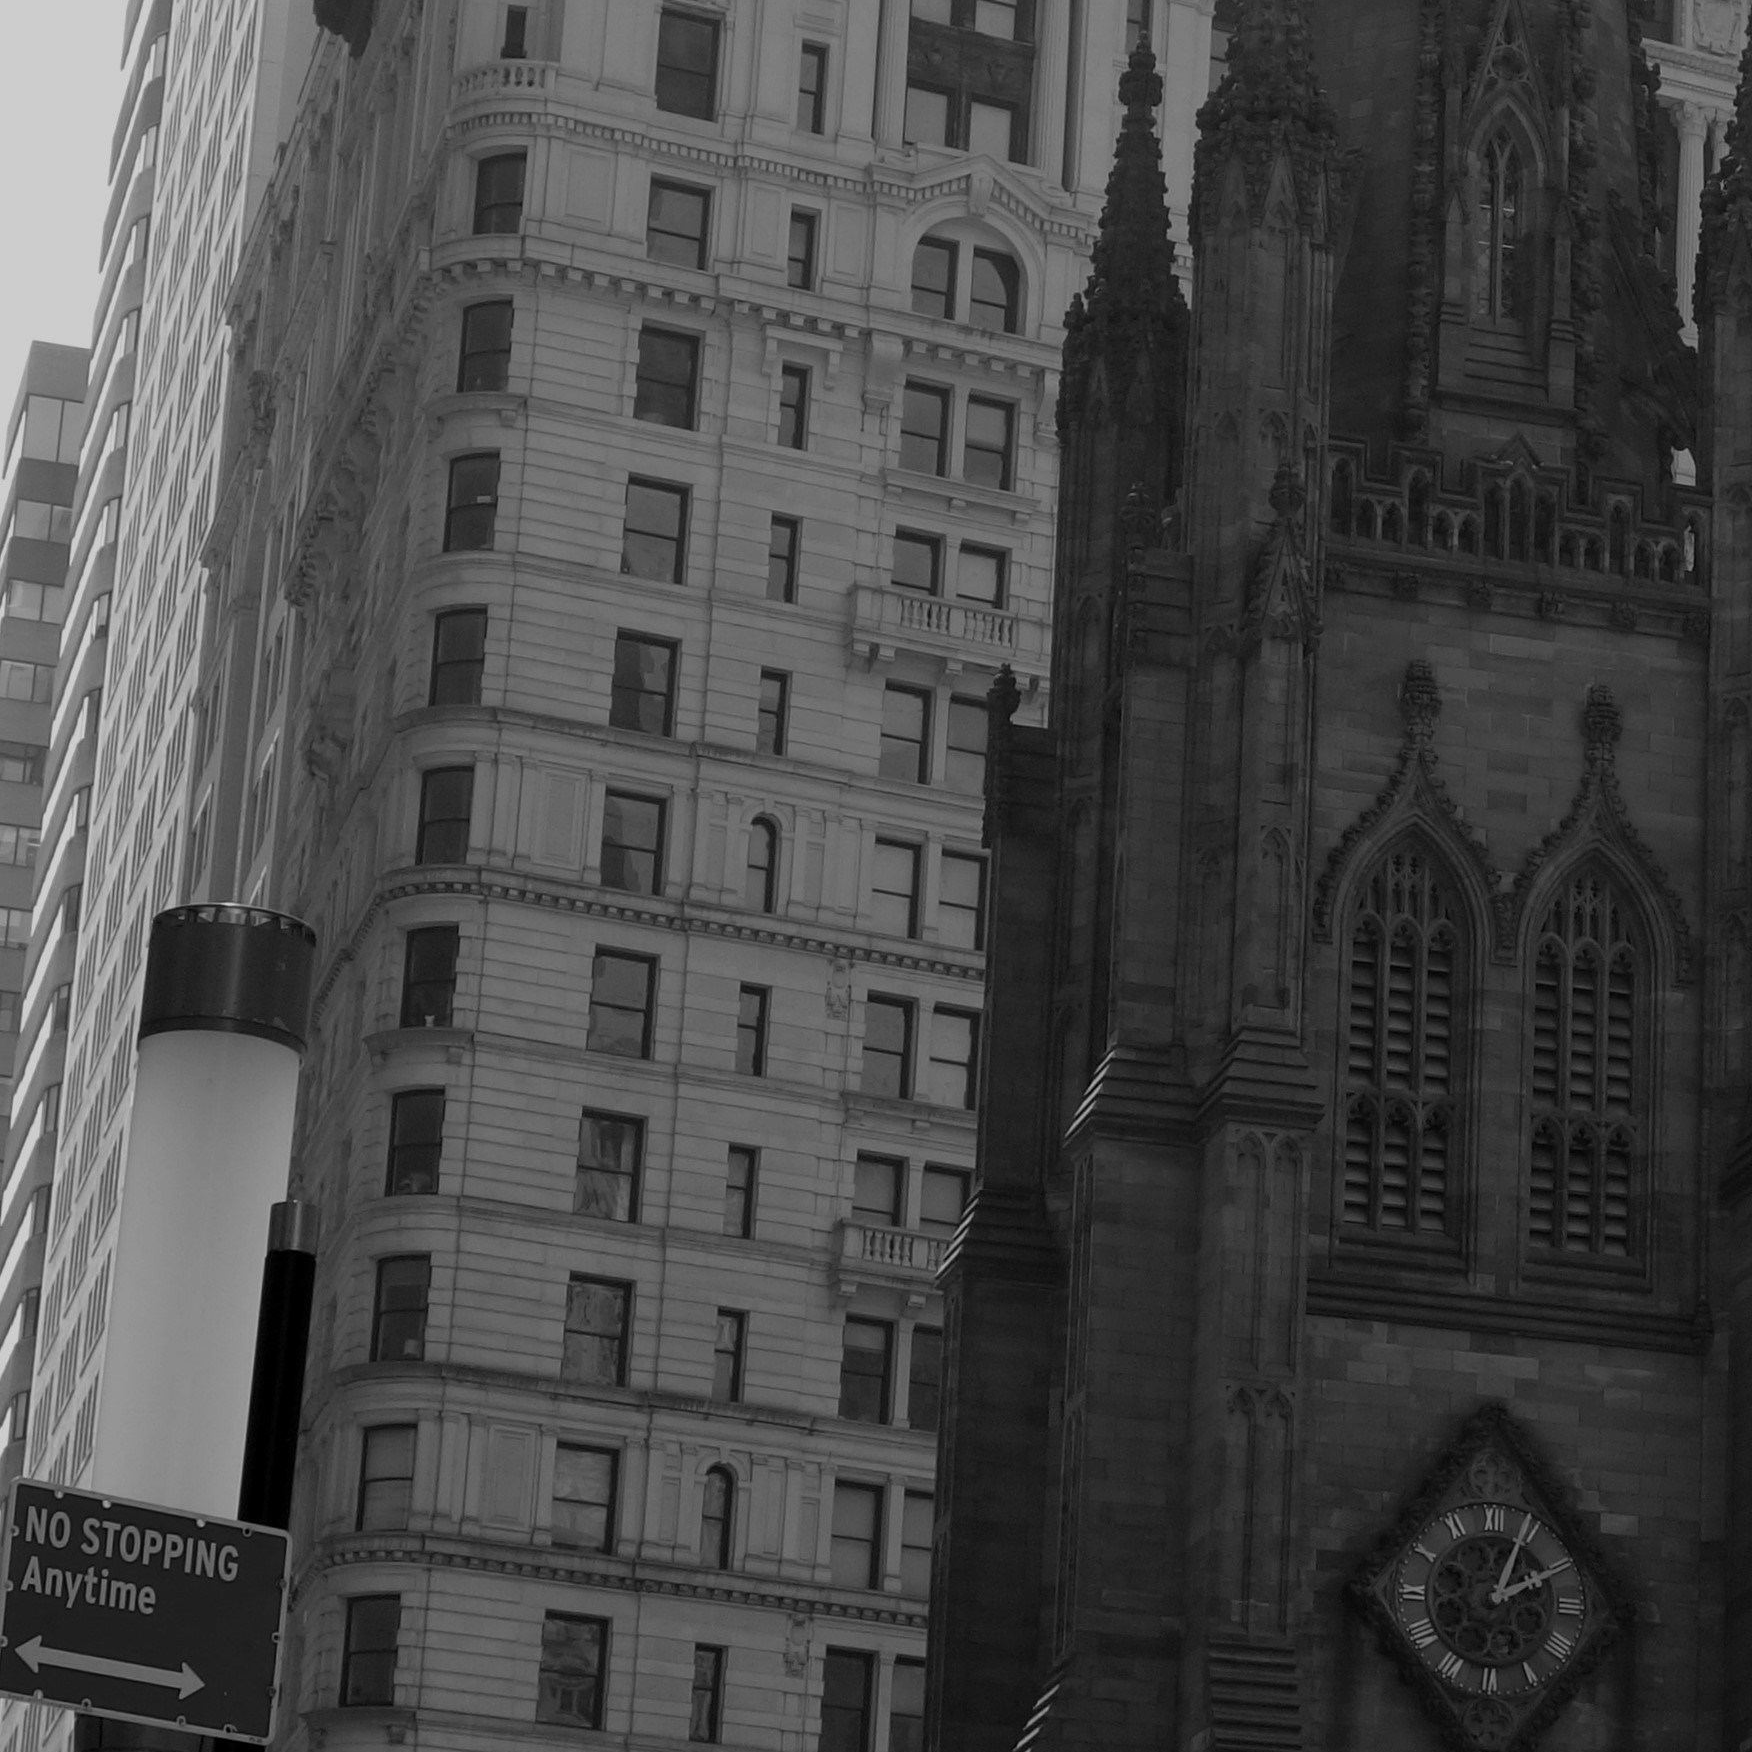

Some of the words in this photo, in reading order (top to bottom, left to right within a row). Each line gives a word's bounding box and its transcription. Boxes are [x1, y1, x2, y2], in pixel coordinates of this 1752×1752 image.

[24, 1505, 71, 1549] NO
[80, 1517, 240, 1582] STOPPING
[20, 1555, 157, 1615] Anytime
